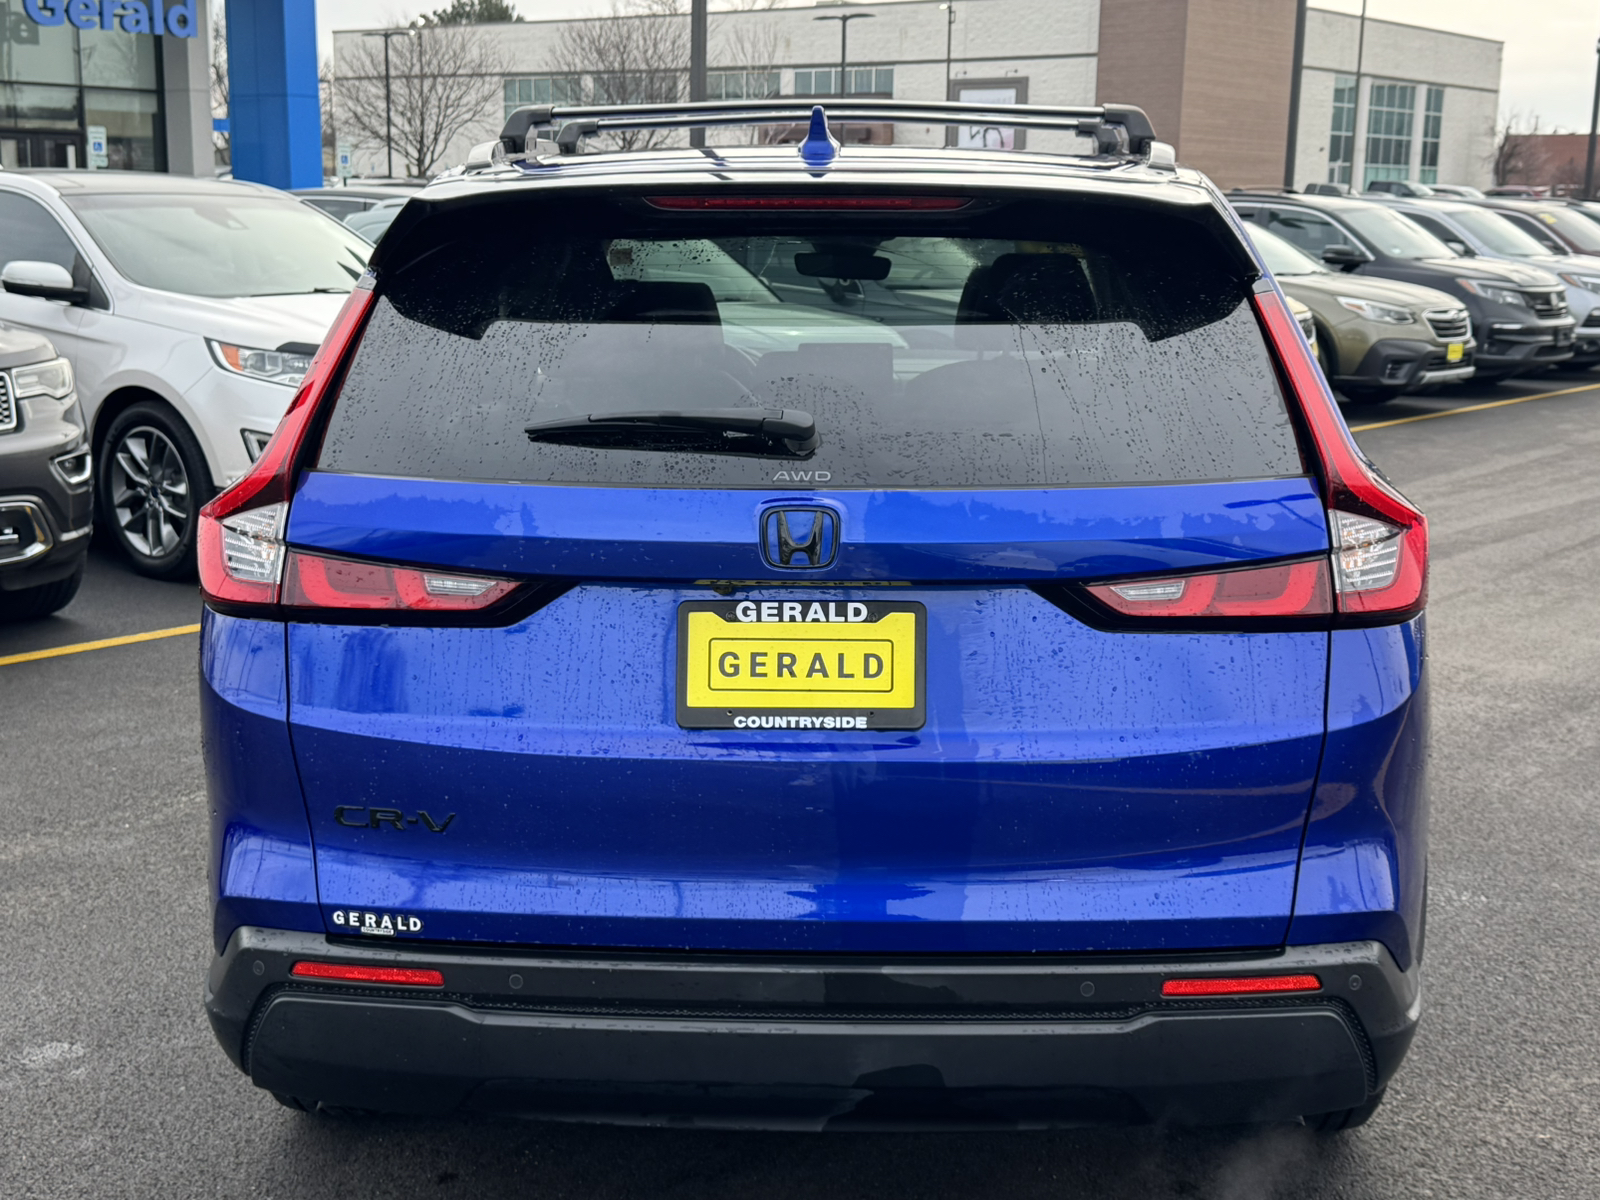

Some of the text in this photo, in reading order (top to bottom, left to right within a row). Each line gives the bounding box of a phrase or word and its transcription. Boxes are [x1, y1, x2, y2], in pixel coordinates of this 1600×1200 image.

[23, 0, 198, 38] Gerald
[772, 470, 831, 482] AWD
[735, 600, 869, 623] GERALD
[718, 651, 884, 679] GERALD
[733, 715, 868, 730] COUNTRYSIDE
[334, 804, 456, 833] CR-V
[332, 910, 422, 932] GERALD
